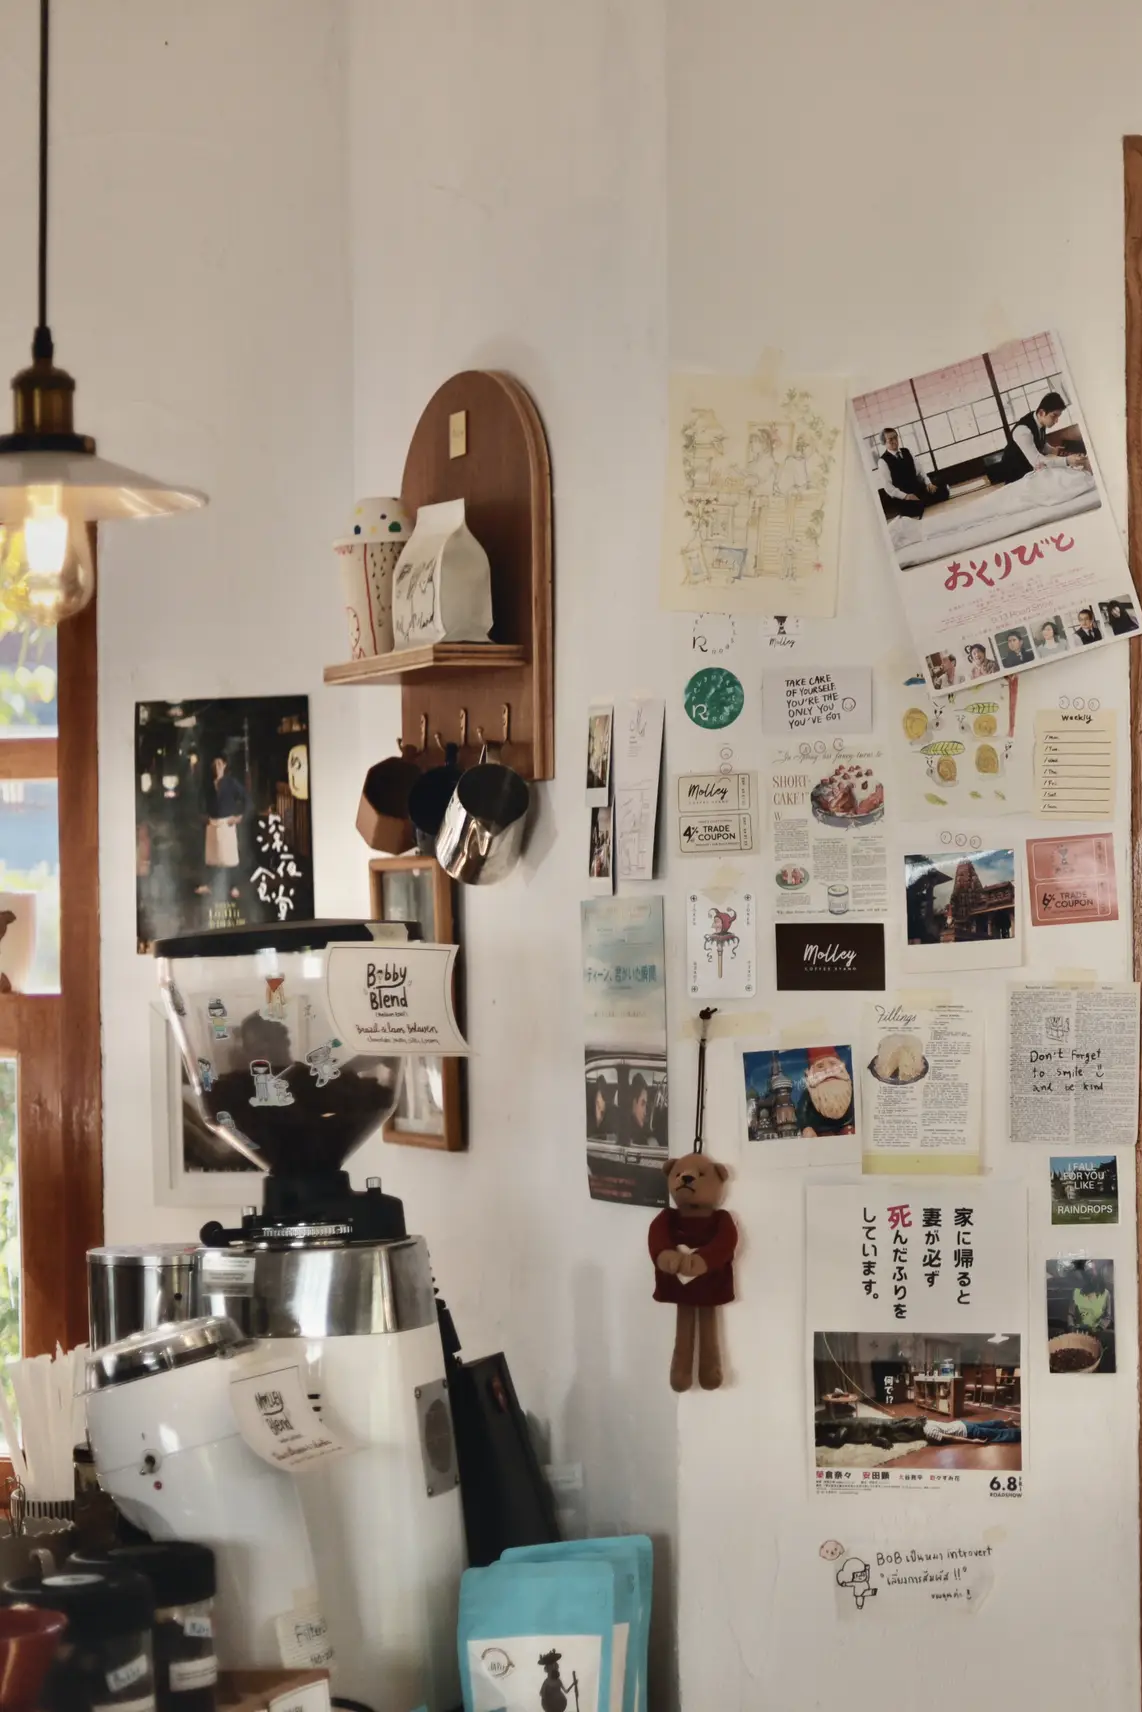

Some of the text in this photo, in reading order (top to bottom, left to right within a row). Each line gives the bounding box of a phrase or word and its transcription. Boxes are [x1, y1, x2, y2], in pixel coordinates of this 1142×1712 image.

[944, 532, 1075, 591] おくりびと
[785, 674, 831, 687] TAKE CARE
[786, 689, 797, 697] OF
[786, 693, 839, 708] YOU'RE THE
[788, 703, 834, 718] ONLY YOU
[788, 712, 841, 729] YOU'VE GOT
[688, 783, 728, 800] Molley
[698, 833, 736, 841] COUPON
[1055, 899, 1094, 908] COUPON
[803, 943, 858, 967] Molley
[369, 986, 409, 1010] Blend
[875, 1004, 918, 1027] Fillings
[1030, 1048, 1063, 1063] Don't
[1032, 1067, 1045, 1079] to
[1032, 1083, 1053, 1092] and
[1064, 1170, 1105, 1181] FOR YOU
[1074, 1181, 1095, 1190] LIKE
[1057, 1204, 1113, 1215] RAINDROPS
[861, 1207, 879, 1300] しています。
[922, 1207, 942, 1288] 妻が必ず
[887, 1204, 913, 1319] 死んだふりを
[953, 1207, 974, 1305] 家に帰ると
[989, 1476, 1018, 1492] 6.8
[947, 1545, 992, 1559] introvert
